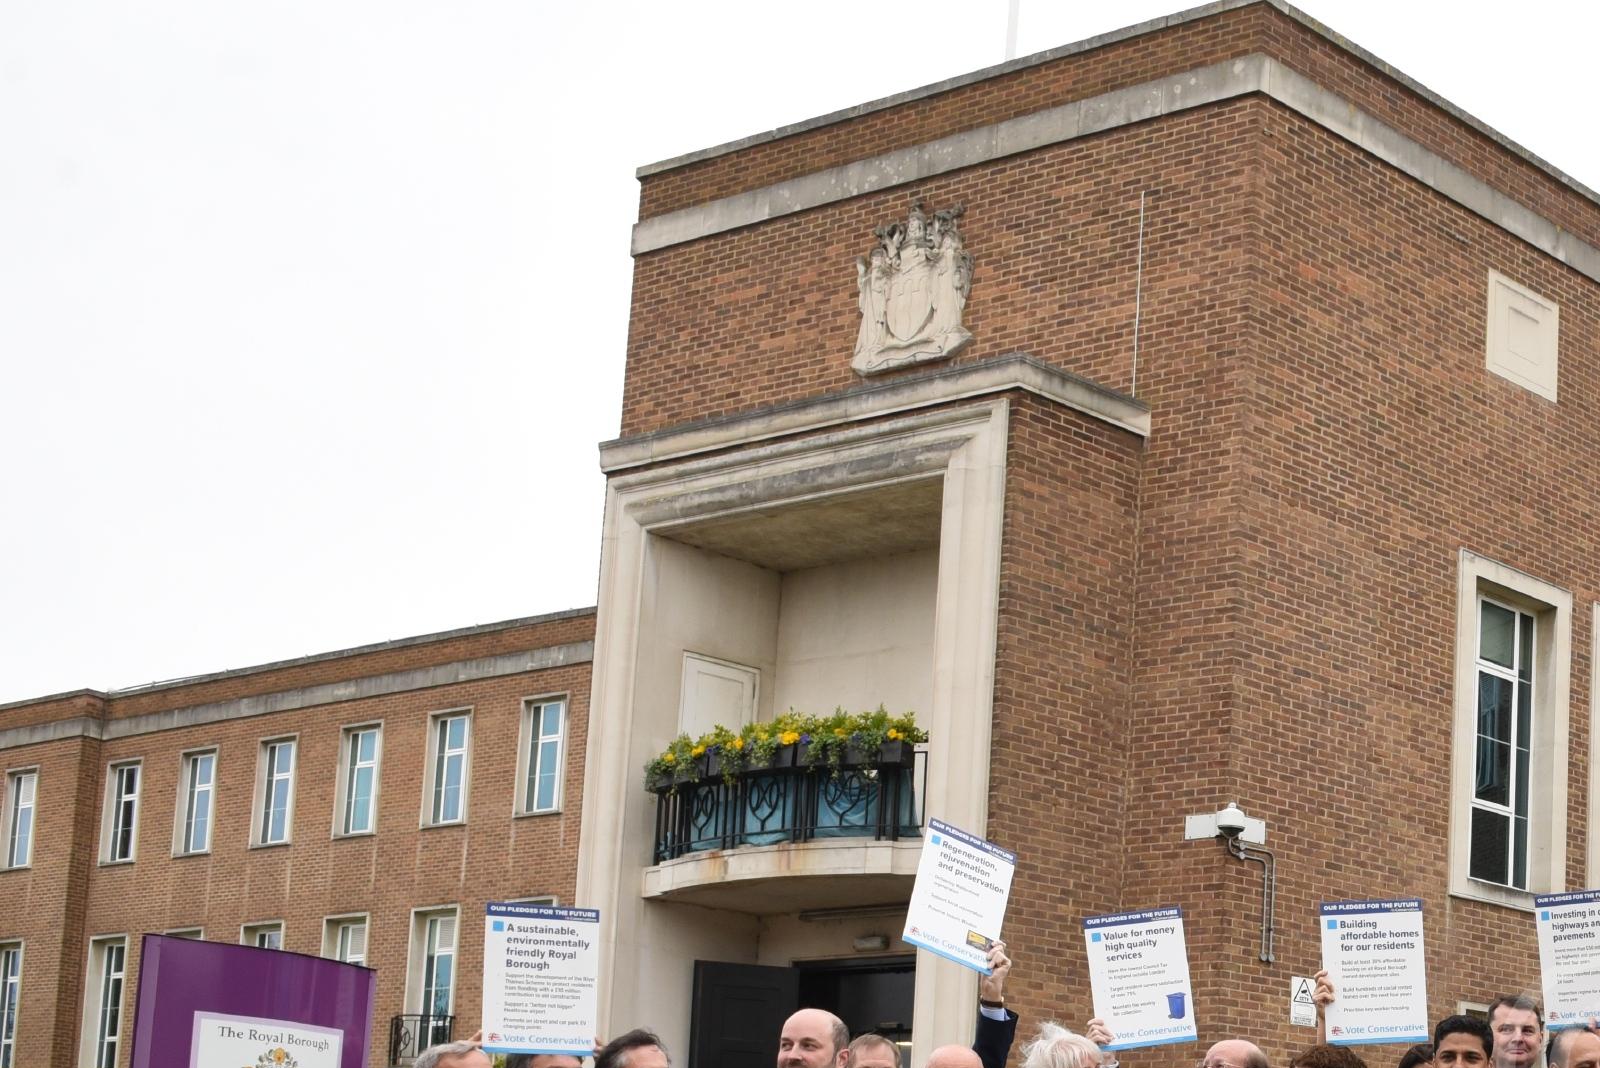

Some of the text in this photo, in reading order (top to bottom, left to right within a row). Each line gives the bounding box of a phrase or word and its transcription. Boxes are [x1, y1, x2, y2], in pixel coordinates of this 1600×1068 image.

[942, 840, 997, 872] Regeneration,
[940, 851, 990, 878] rejuvenation
[938, 861, 954, 872] and
[955, 869, 1004, 895] preservation
[1551, 909, 1587, 920] Investing
[1588, 908, 1596, 916] in
[507, 923, 579, 937] A sustainable,
[1340, 919, 1377, 930] Building
[1552, 922, 1590, 932] highways
[1103, 926, 1175, 941] Value for money
[1340, 930, 1420, 940] affordable homes
[1553, 931, 1596, 943] pavements
[507, 936, 590, 951] environmentally
[1105, 938, 1157, 952] high quality
[1341, 943, 1354, 952] for
[1373, 941, 1415, 950] residents
[506, 947, 577, 961] friendly Royal
[1106, 952, 1143, 962] services
[506, 959, 550, 971] Borough
[218, 1026, 329, 1051] The Royal Borough
